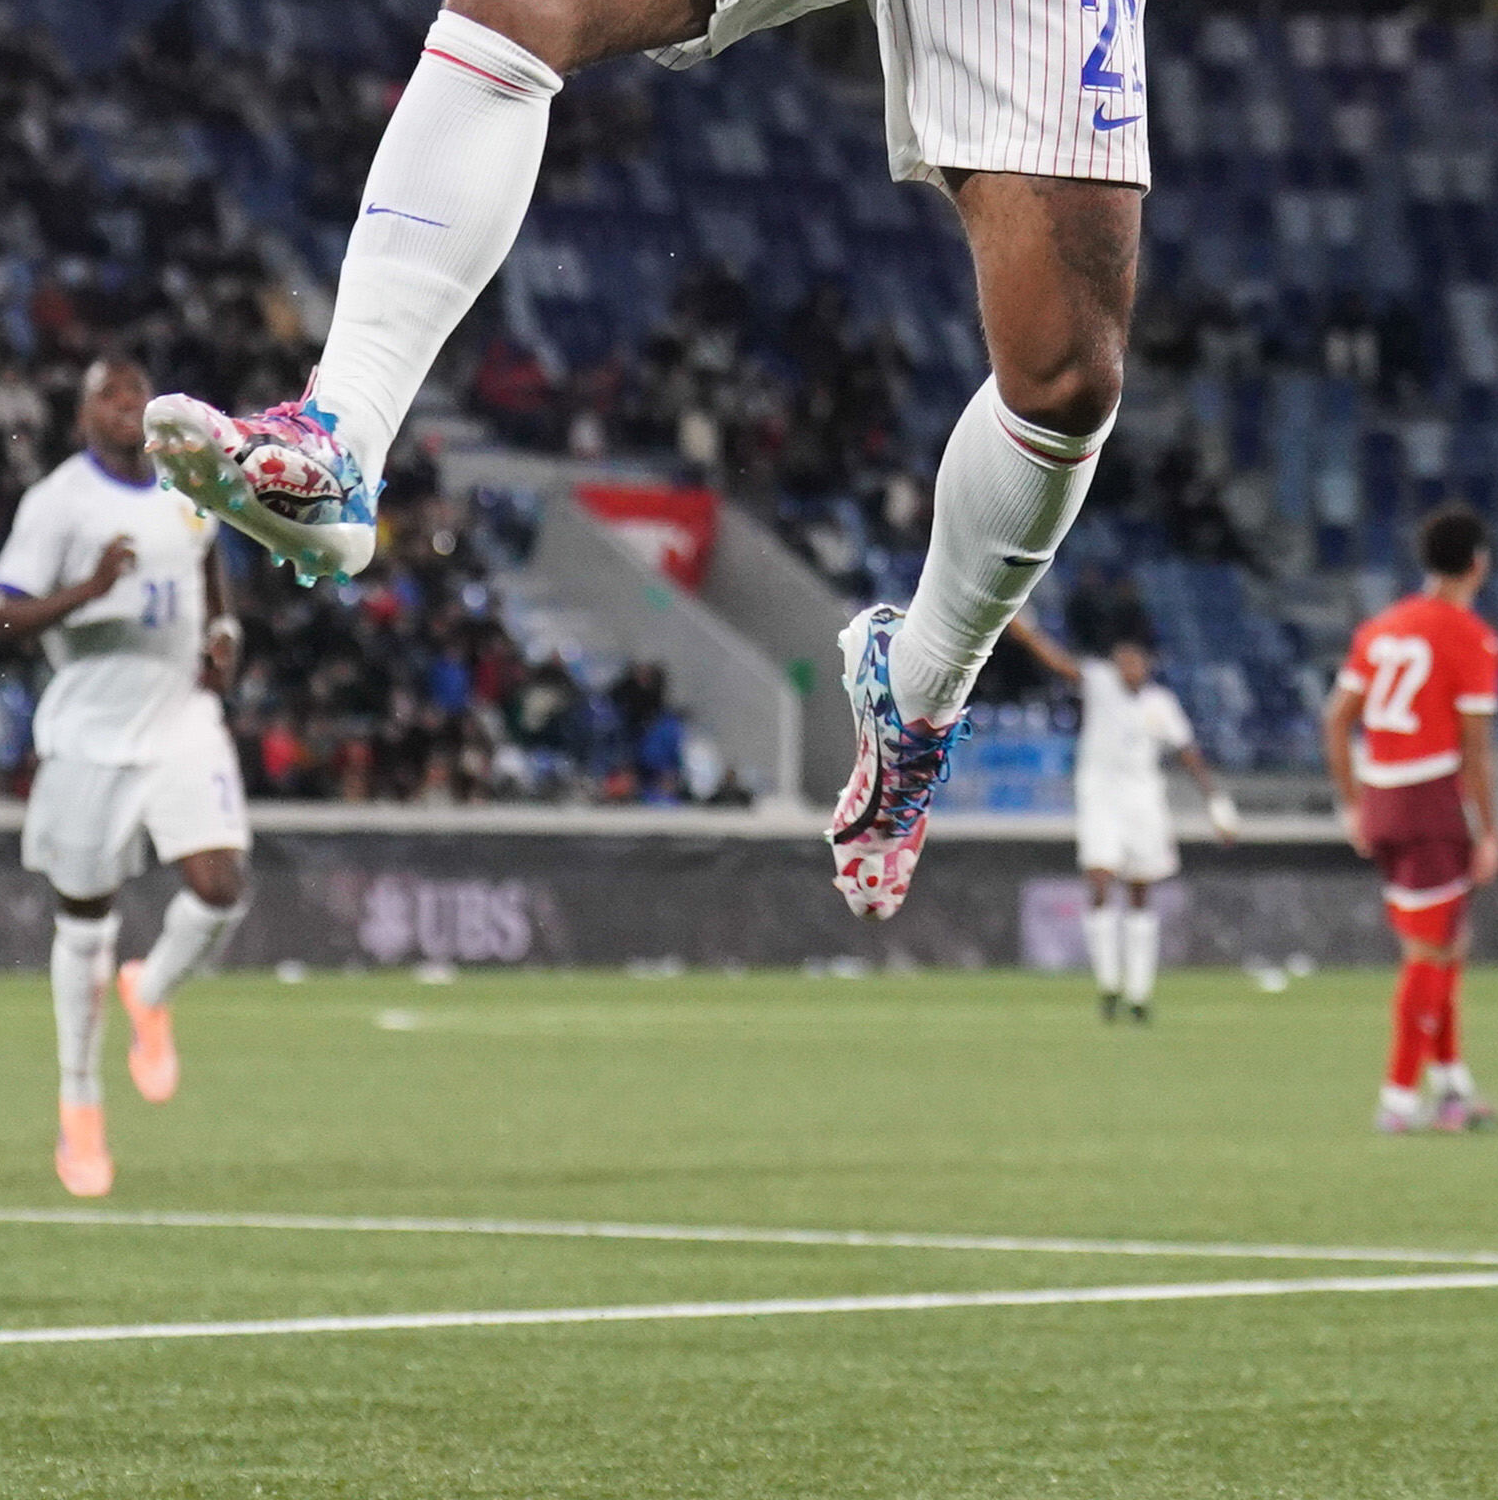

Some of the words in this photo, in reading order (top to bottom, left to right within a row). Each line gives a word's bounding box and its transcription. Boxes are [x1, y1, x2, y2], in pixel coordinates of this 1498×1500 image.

[141, 578, 177, 629] 21
[1363, 635, 1433, 735] 22
[418, 880, 532, 962] UBS
